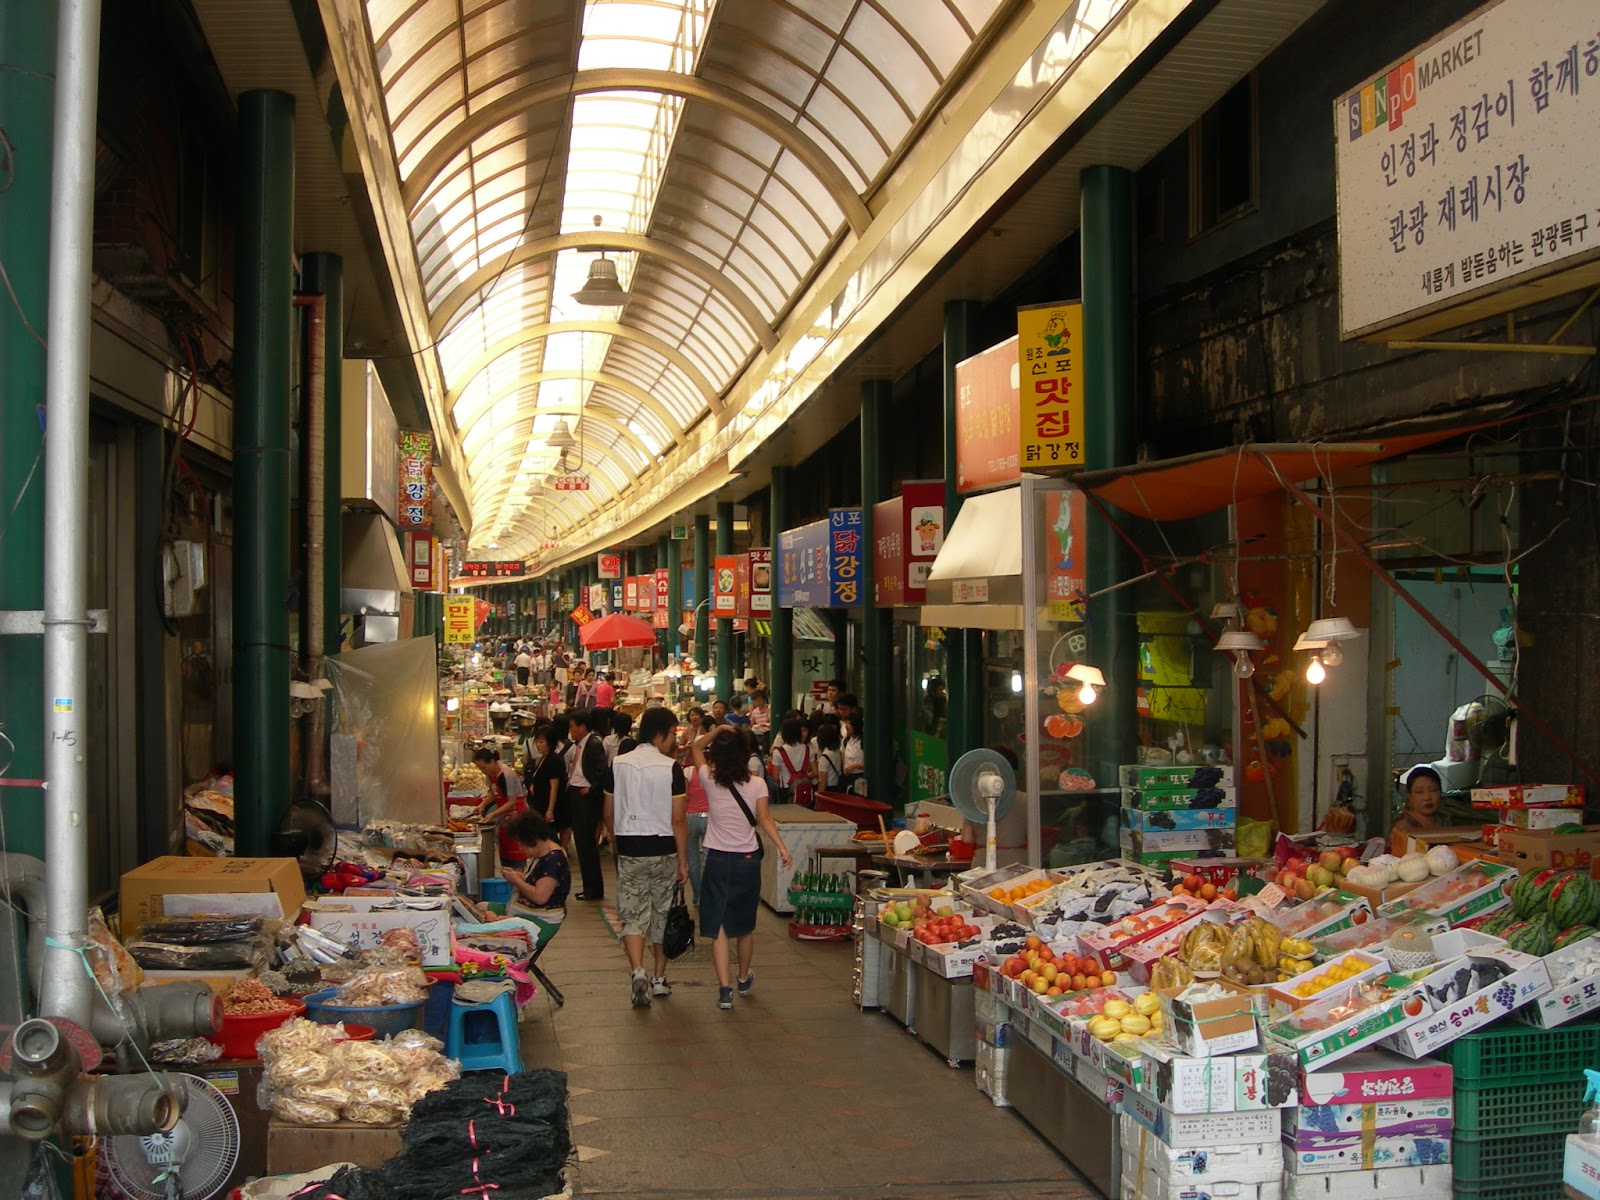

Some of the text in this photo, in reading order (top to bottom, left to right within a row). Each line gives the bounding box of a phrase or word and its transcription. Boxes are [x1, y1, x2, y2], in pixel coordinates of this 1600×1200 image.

[1350, 29, 1484, 133] SINPO MARKET
[1381, 123, 1439, 188] 인정과
[1449, 79, 1515, 153] 정감이
[1388, 154, 1530, 254] 관광 재래시장
[1421, 265, 1455, 296] 새롭게
[1461, 240, 1524, 284] 발돋움하는
[1531, 213, 1589, 257] 관광특구
[1025, 347, 1043, 362] 원조
[1031, 359, 1072, 375] 신포
[1035, 377, 1072, 439] 맛집
[402, 435, 431, 452] 신포
[1025, 442, 1080, 462] 닭강정
[407, 459, 426, 524] 닭강정
[832, 511, 861, 527] 신포
[601, 555, 620, 577] 약
[833, 530, 860, 604] 닭강정
[449, 605, 471, 633] 만두
[448, 633, 473, 642] 전문
[1169, 774, 1190, 785] 포도
[1171, 794, 1192, 805] 포도
[1550, 847, 1592, 869] Dole
[1261, 886, 1281, 905] 1000
[1582, 982, 1598, 999] 포
[1242, 1068, 1258, 1101] 거봉
[1415, 1122, 1437, 1130] Grapes
